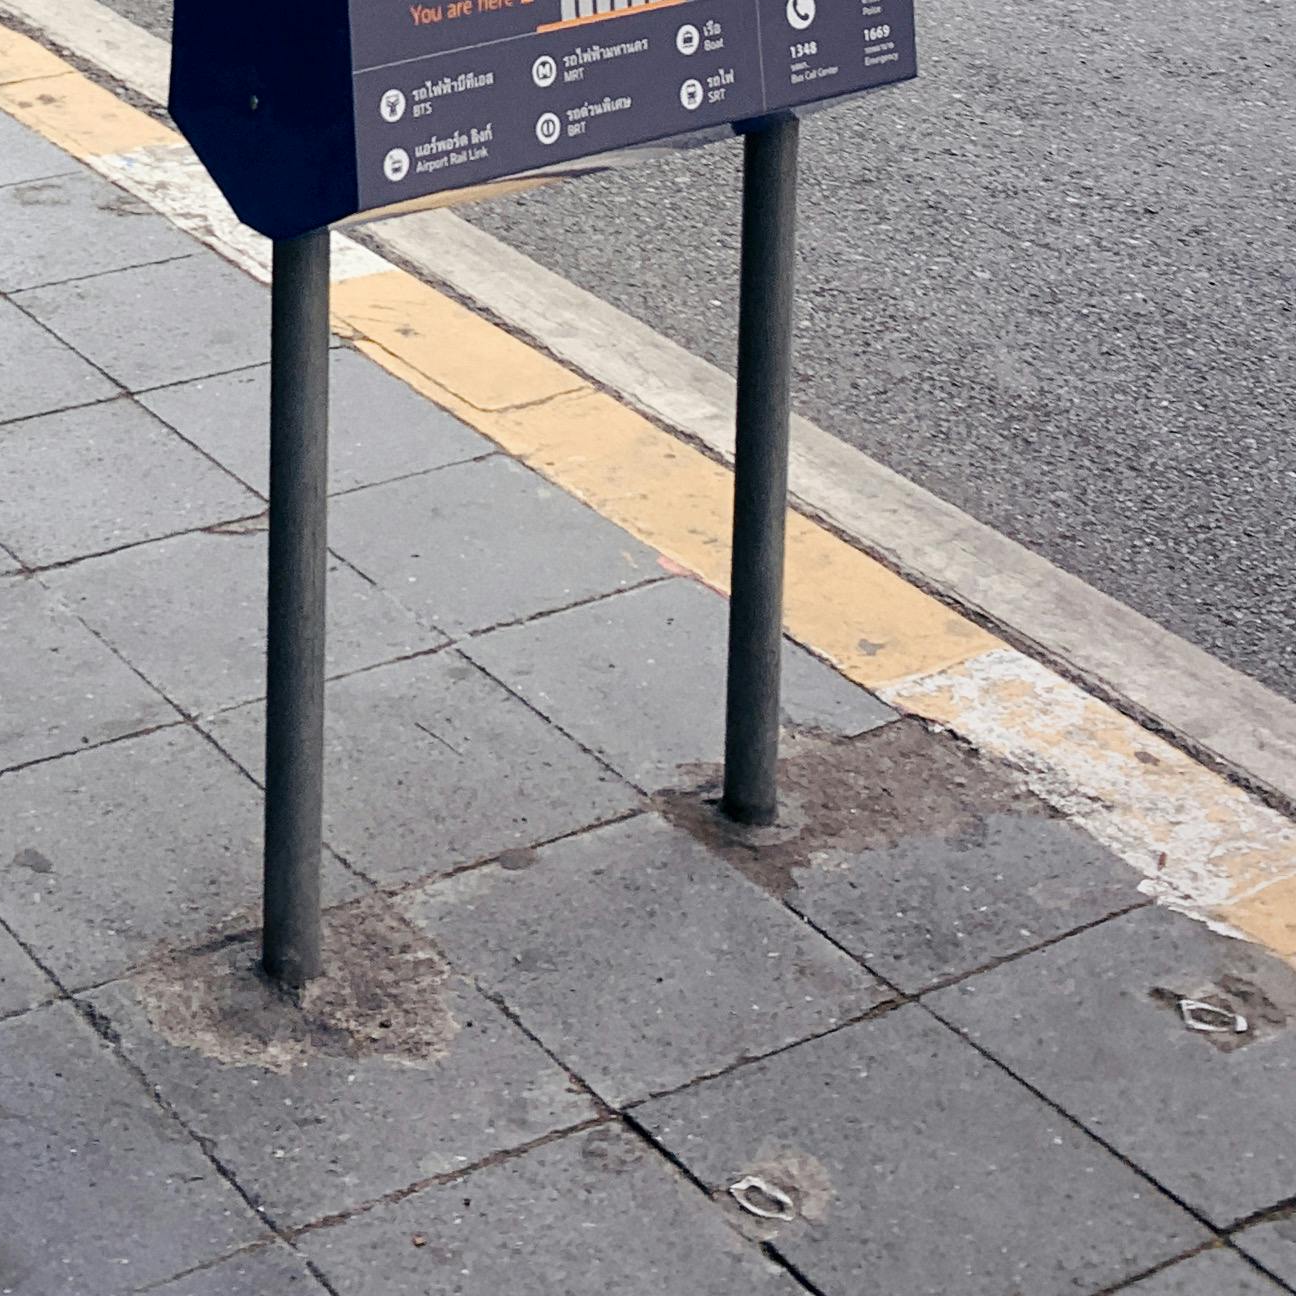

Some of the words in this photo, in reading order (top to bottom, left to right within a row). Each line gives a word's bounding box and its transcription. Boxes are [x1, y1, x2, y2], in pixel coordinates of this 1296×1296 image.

[410, 3, 443, 26] You
[447, 0, 472, 19] are
[864, 25, 890, 41] 1669
[563, 38, 648, 67] รถไฟฟ้ามหานคร
[790, 41, 817, 58] 1348
[564, 67, 584, 82] MRT
[707, 68, 734, 88] รถไฟ
[412, 72, 494, 101] รถไฟฟ้าบีทีเอส
[708, 88, 726, 103] SRT
[413, 102, 432, 118] BTS
[566, 96, 632, 121] รถด่วนพิเศษ
[416, 156, 449, 173] Airport
[450, 150, 467, 165] Rail
[469, 146, 489, 161] Link
